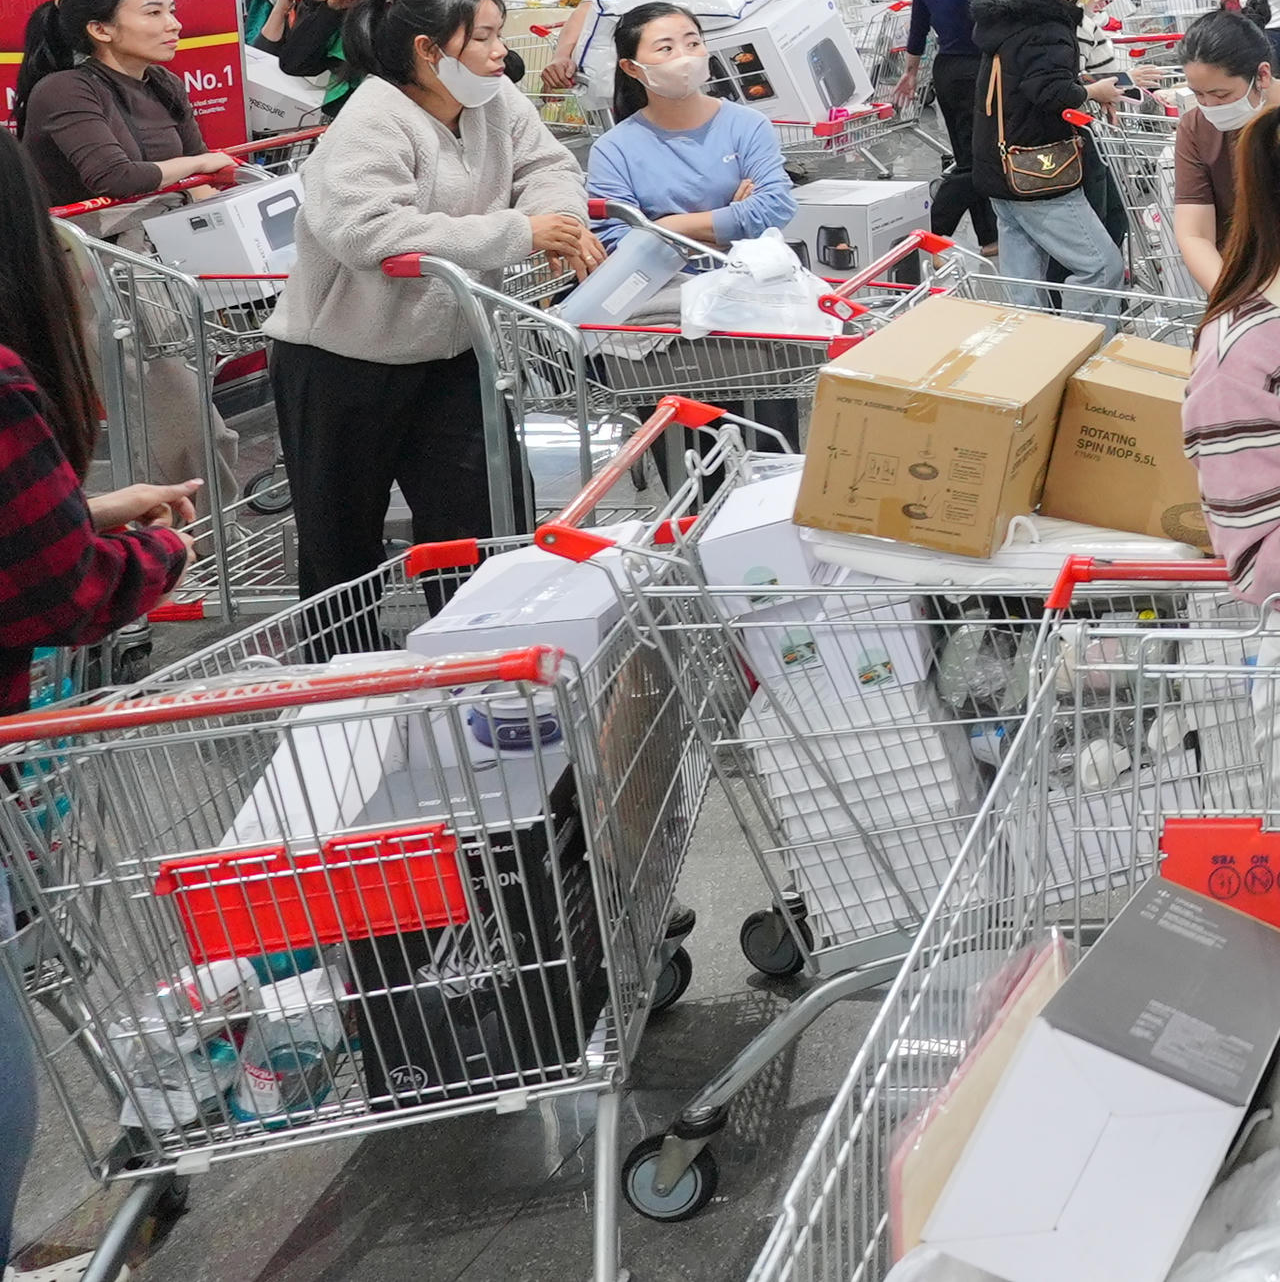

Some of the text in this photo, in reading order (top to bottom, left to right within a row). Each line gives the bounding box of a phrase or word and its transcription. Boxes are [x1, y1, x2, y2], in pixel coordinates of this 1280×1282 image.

[183, 65, 235, 94] No.1
[1085, 402, 1137, 423] LocknLock
[1080, 425, 1138, 447] ROTATING
[1076, 438, 1104, 454] SPIN
[1105, 443, 1135, 460] MOP
[1134, 451, 1157, 468] 5.5L
